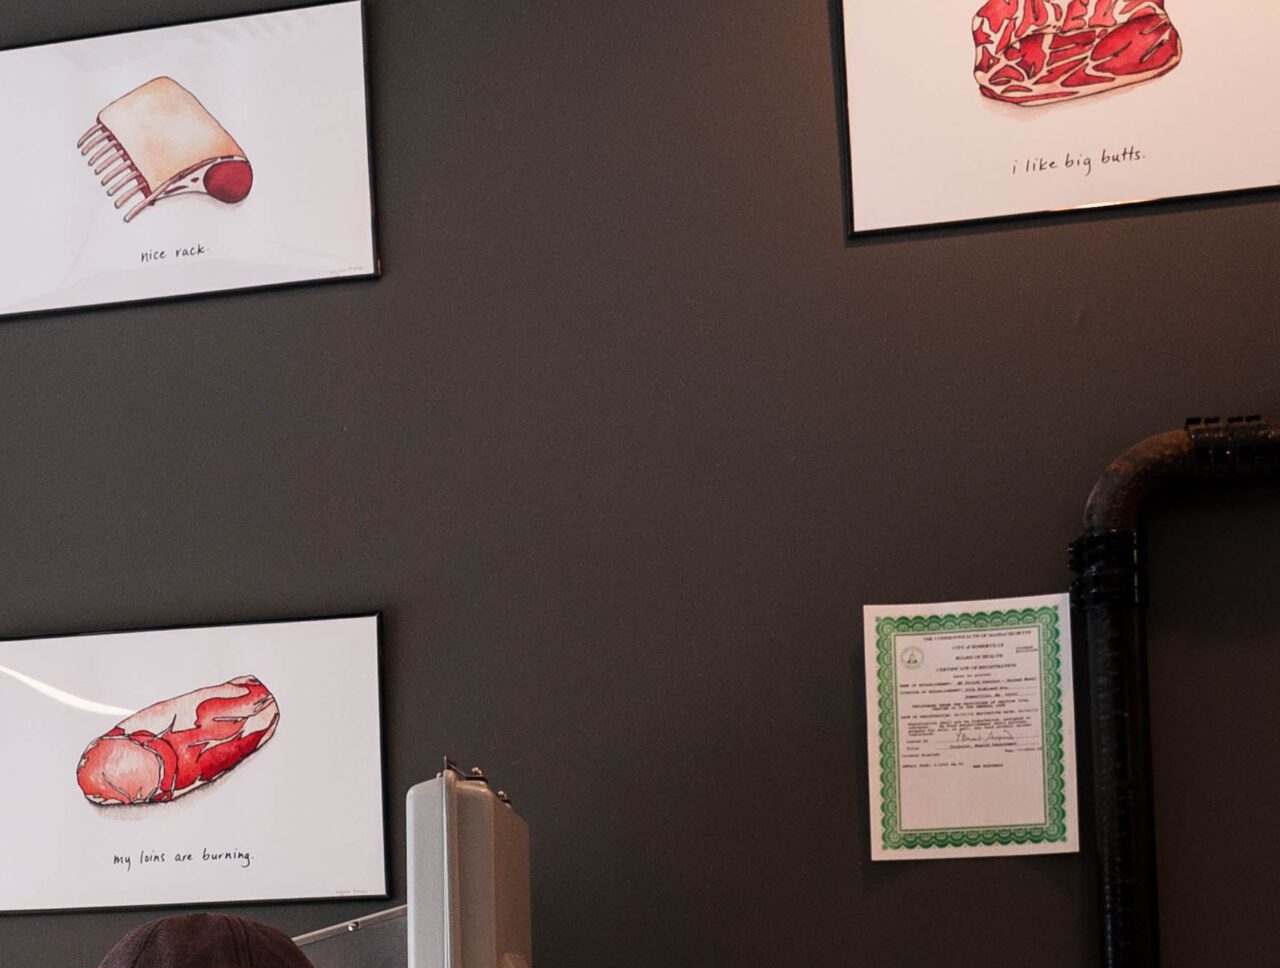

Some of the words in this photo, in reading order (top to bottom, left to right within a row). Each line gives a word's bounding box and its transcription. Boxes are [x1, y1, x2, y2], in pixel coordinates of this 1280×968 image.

[1025, 158, 1058, 173] like
[1065, 153, 1091, 177] big
[1101, 145, 1147, 164] butts.
[140, 248, 167, 263] nice
[113, 854, 131, 871] my
[140, 849, 165, 864] loins
[175, 853, 193, 862] are
